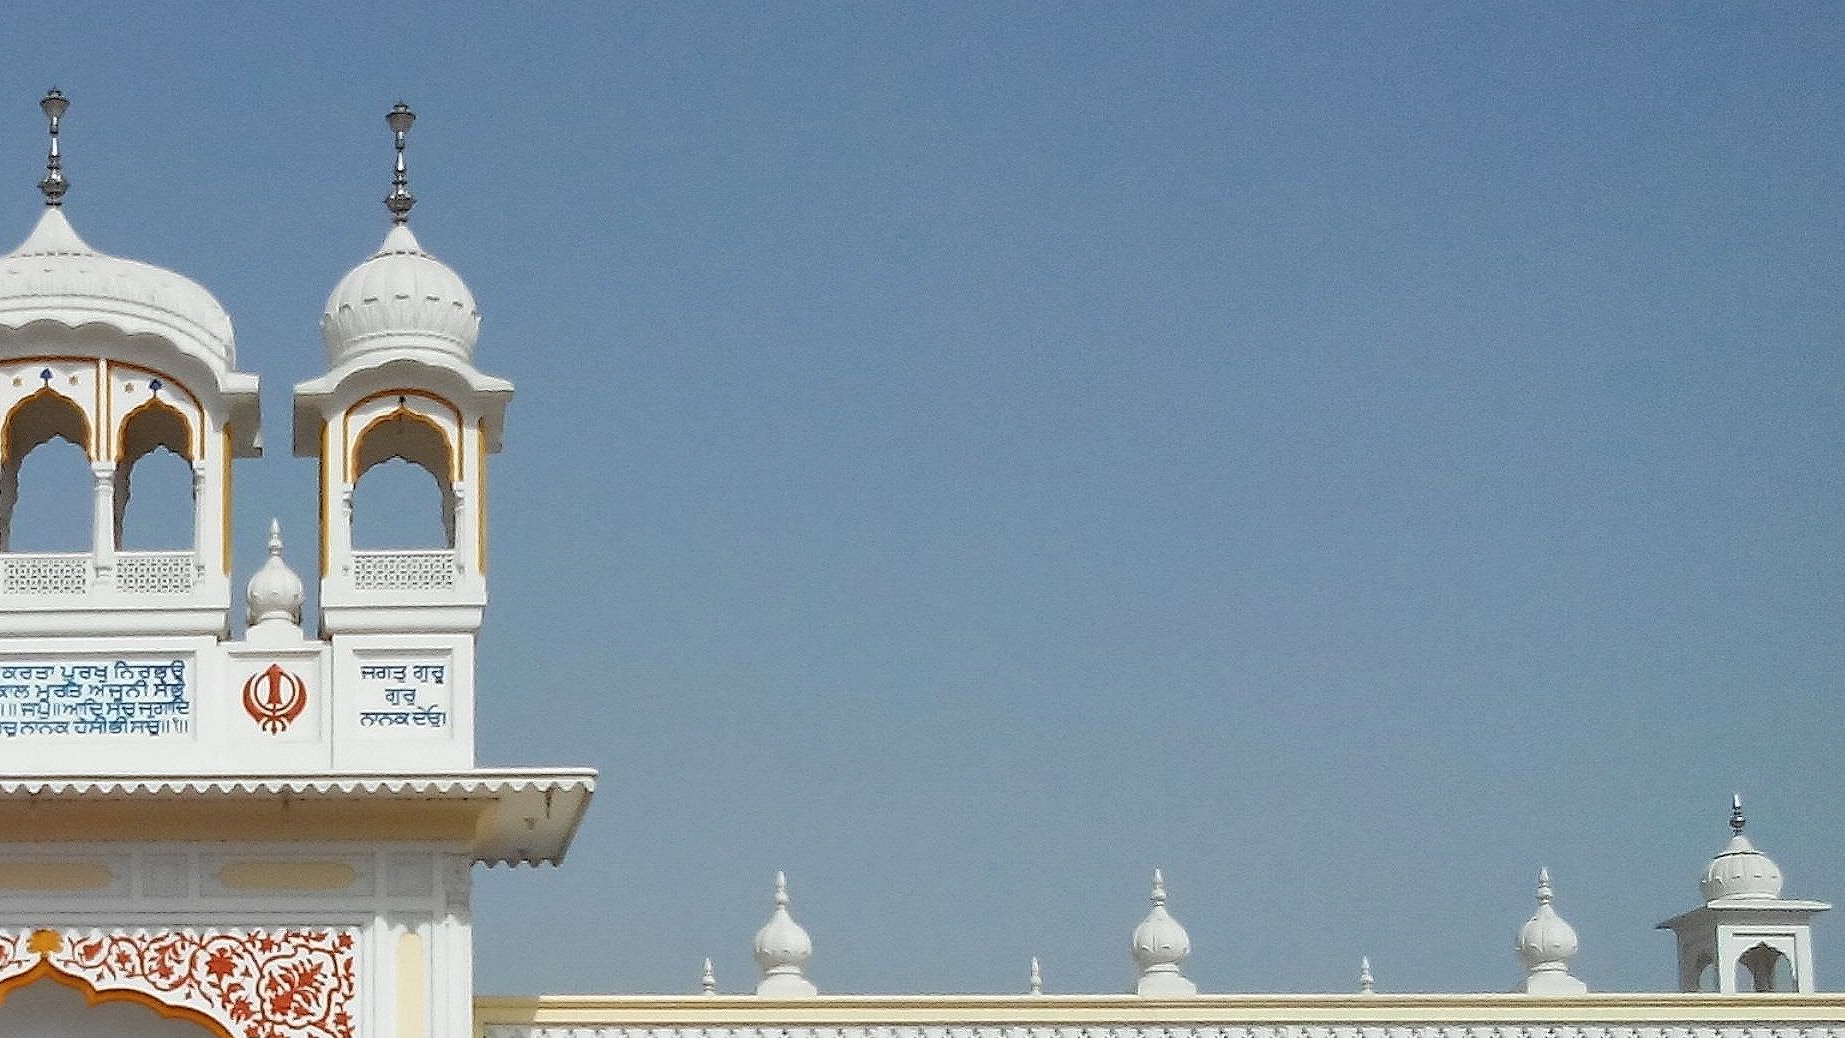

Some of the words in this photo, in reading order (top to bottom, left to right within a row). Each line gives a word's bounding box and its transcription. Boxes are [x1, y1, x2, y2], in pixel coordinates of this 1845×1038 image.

[1, 666, 54, 680] ਕਰਤਾ
[360, 712, 409, 727] ਨਾਨਕ
[21, 721, 70, 735] ਨਾਨਕ
